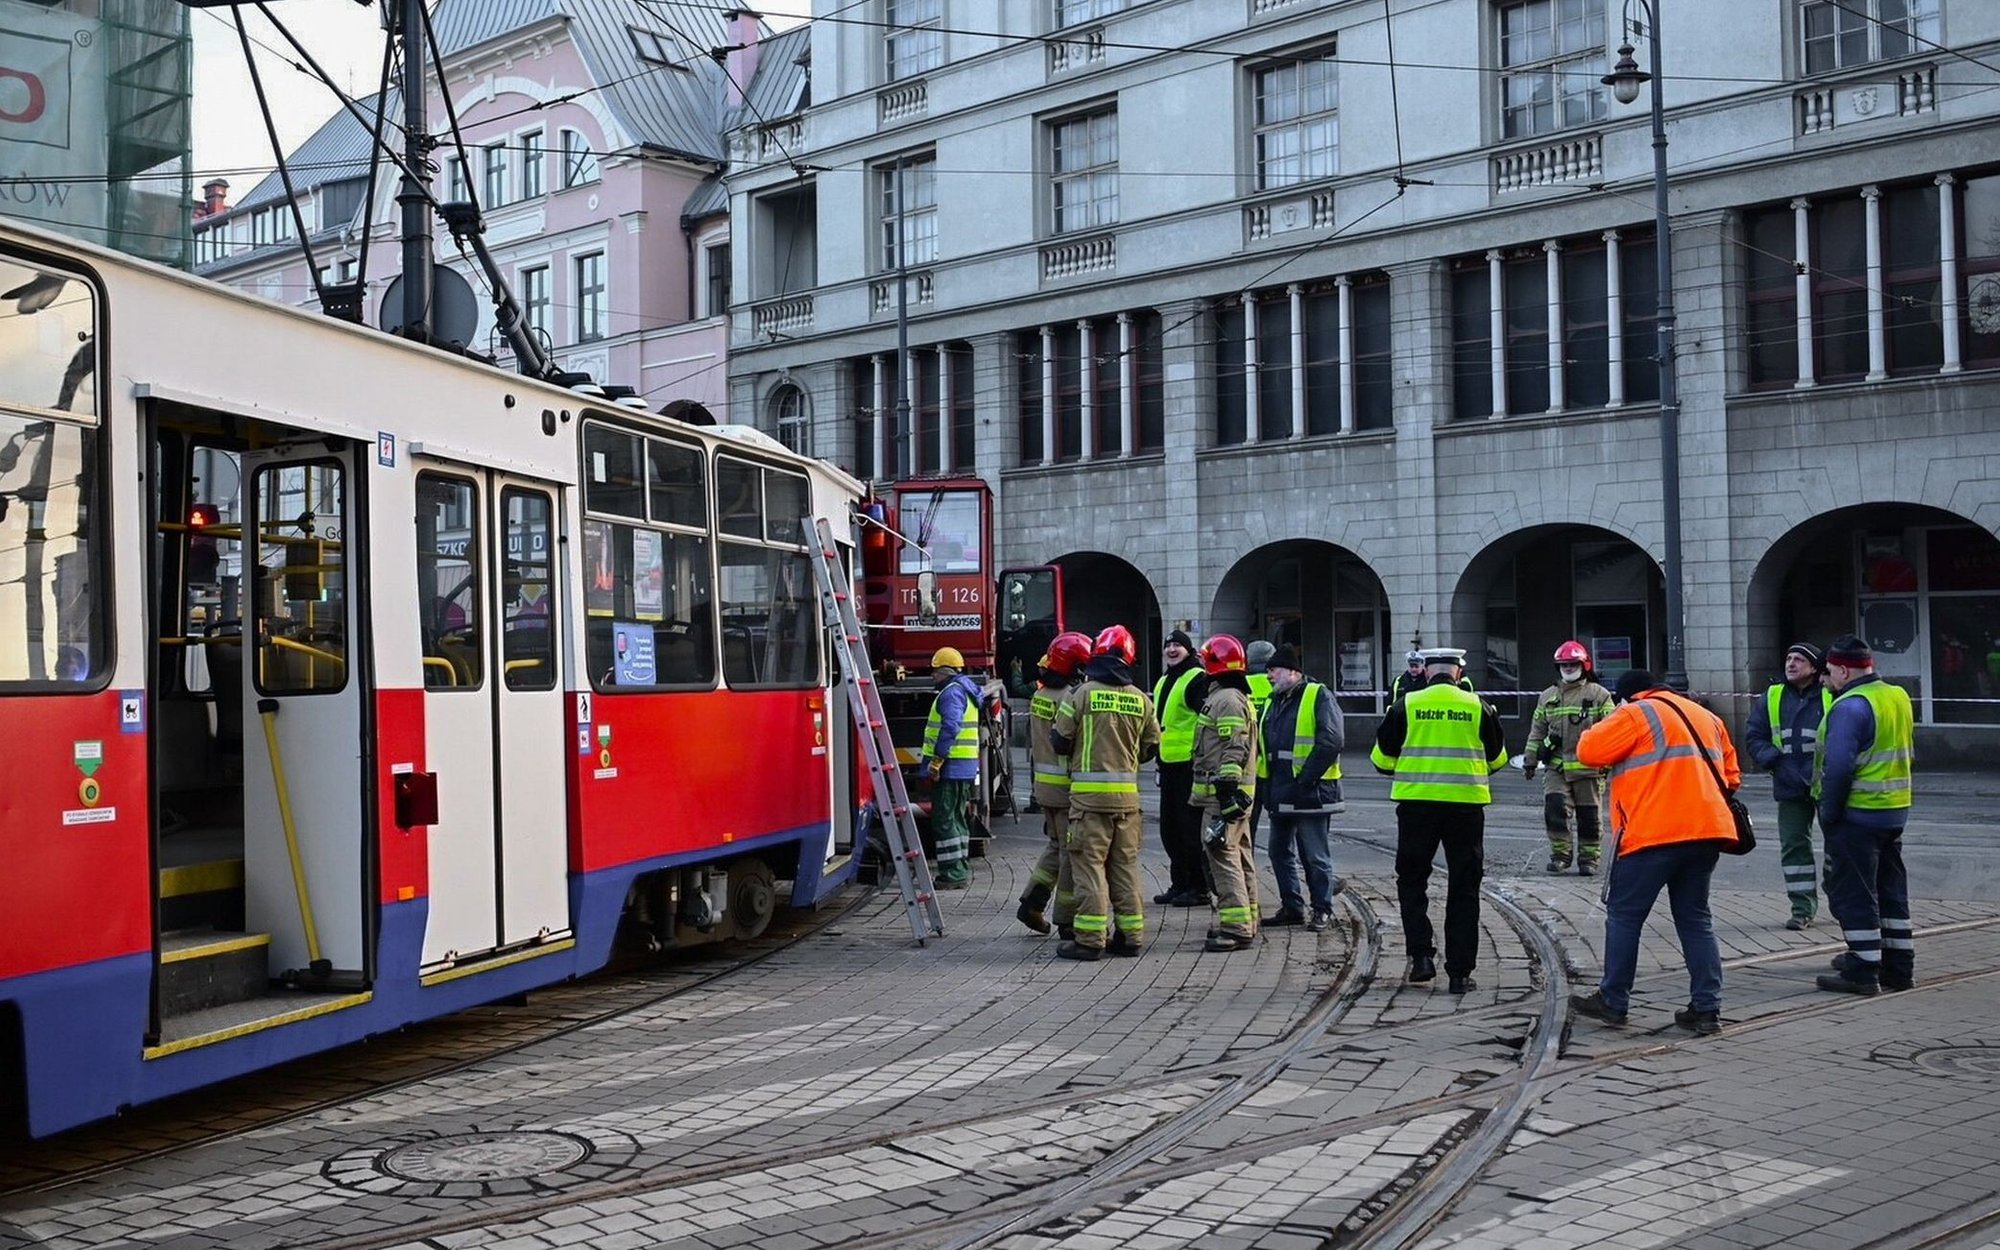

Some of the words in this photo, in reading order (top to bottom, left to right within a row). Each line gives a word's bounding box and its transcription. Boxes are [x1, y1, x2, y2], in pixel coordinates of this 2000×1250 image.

[900, 588, 943, 604] TRM
[952, 587, 980, 603] 126
[1415, 708, 1445, 720] Nadzór
[1447, 709, 1473, 722] Ruchu
